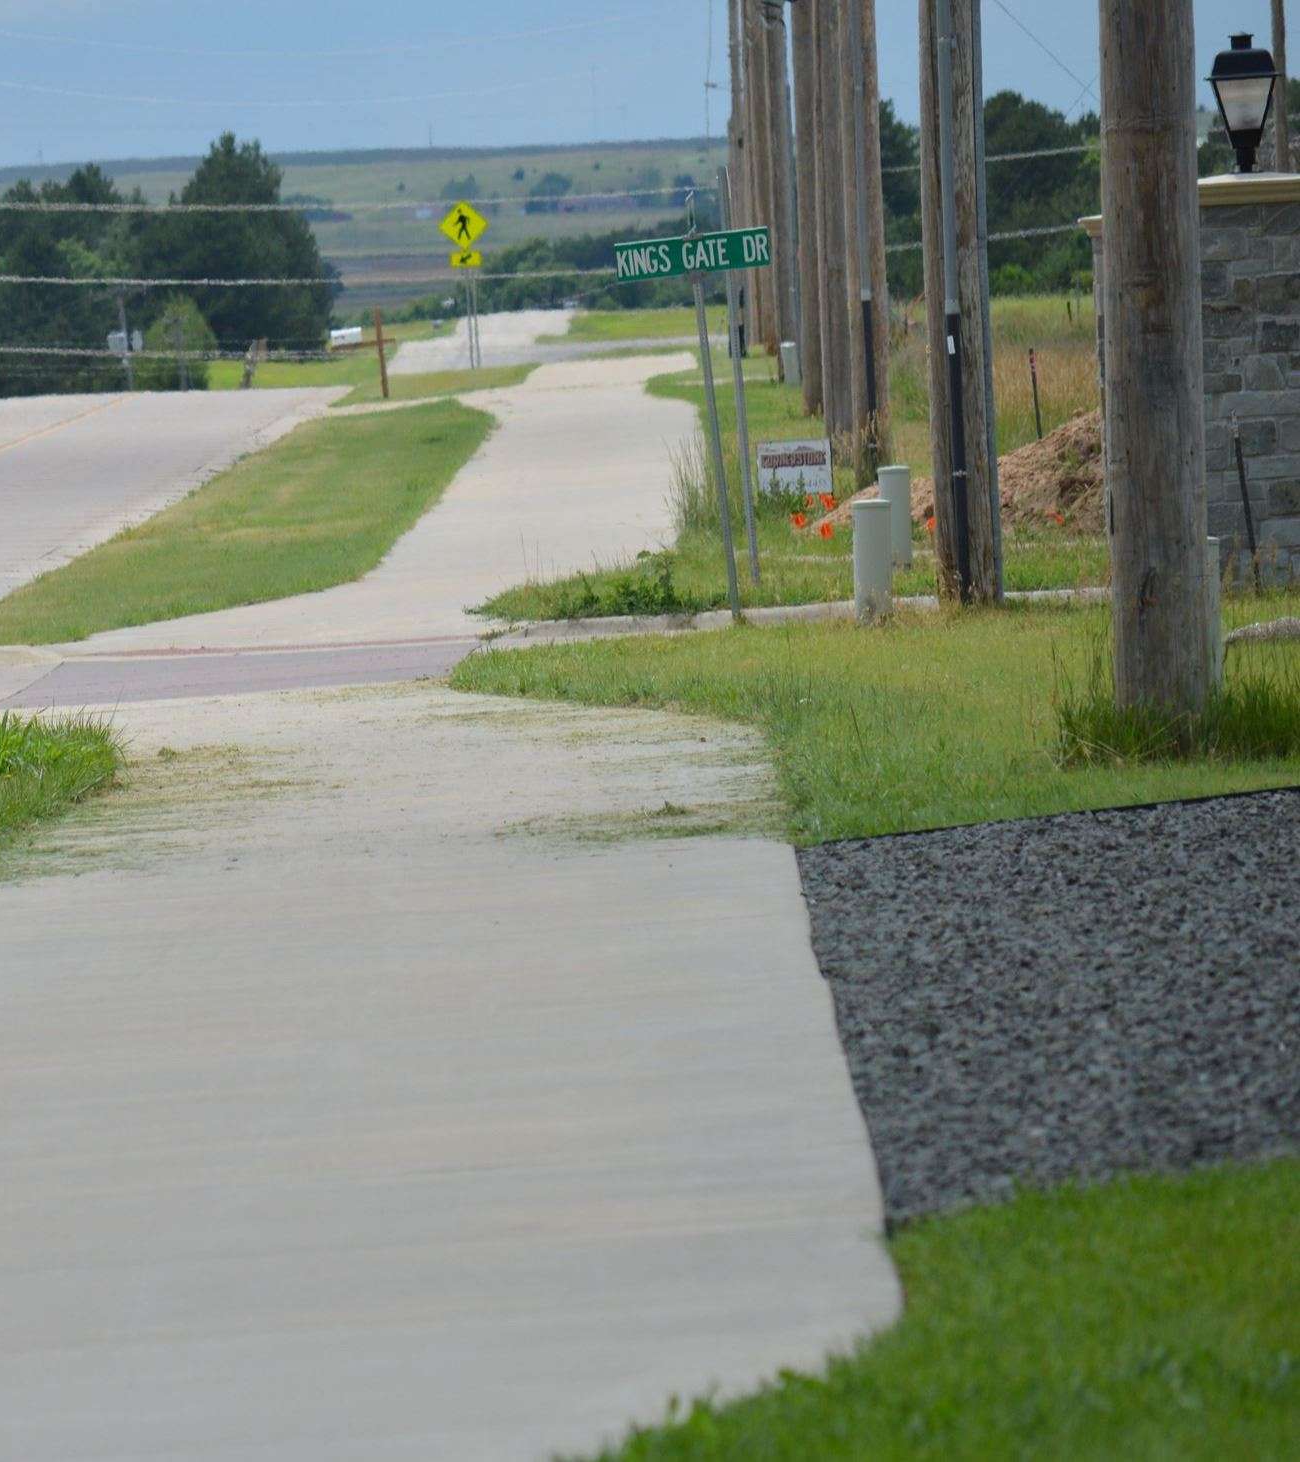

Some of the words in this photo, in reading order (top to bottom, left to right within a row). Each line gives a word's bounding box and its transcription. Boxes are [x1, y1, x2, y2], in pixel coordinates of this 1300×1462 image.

[616, 244, 672, 278] KINGS
[682, 238, 729, 270] GATE
[742, 234, 769, 263] DR
